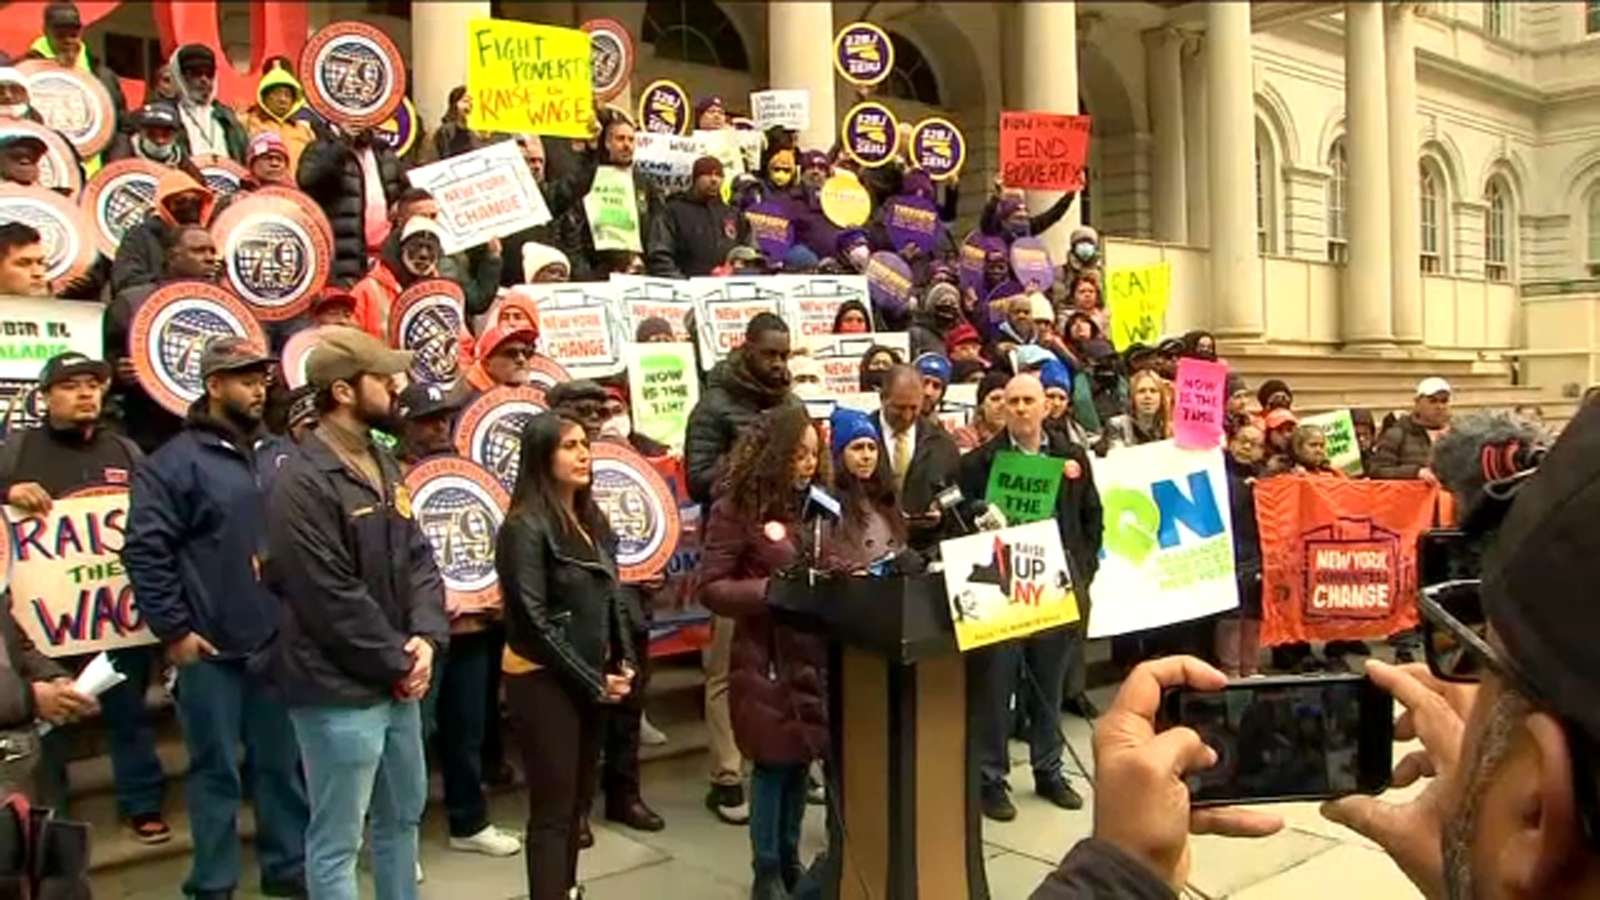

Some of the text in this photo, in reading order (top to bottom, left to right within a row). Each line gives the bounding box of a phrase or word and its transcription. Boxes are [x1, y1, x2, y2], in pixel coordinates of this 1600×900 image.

[475, 28, 546, 68] FIGHT
[322, 54, 387, 97] 79
[526, 97, 593, 127] WAGE
[1015, 136, 1069, 160] END
[1003, 161, 1082, 185] POVERTY
[454, 194, 522, 229] CHANGE
[239, 238, 302, 285] 79
[715, 306, 742, 321] NEW
[1122, 314, 1159, 343] WA
[548, 339, 607, 358] CHANGE
[644, 369, 683, 383] NOW
[1183, 379, 1218, 392] NOW
[661, 384, 689, 398] THE
[997, 472, 1052, 495] RAISE
[1004, 494, 1042, 514] THE
[11, 509, 127, 562] RAIS
[420, 507, 496, 567] 79
[1014, 541, 1046, 558] RAISE
[1315, 549, 1387, 570] NEW YORK
[67, 559, 121, 584] THE
[1014, 555, 1046, 580] UP
[1014, 580, 1046, 607] NY
[1313, 584, 1390, 609] CHANGE
[31, 584, 143, 646] WAG
